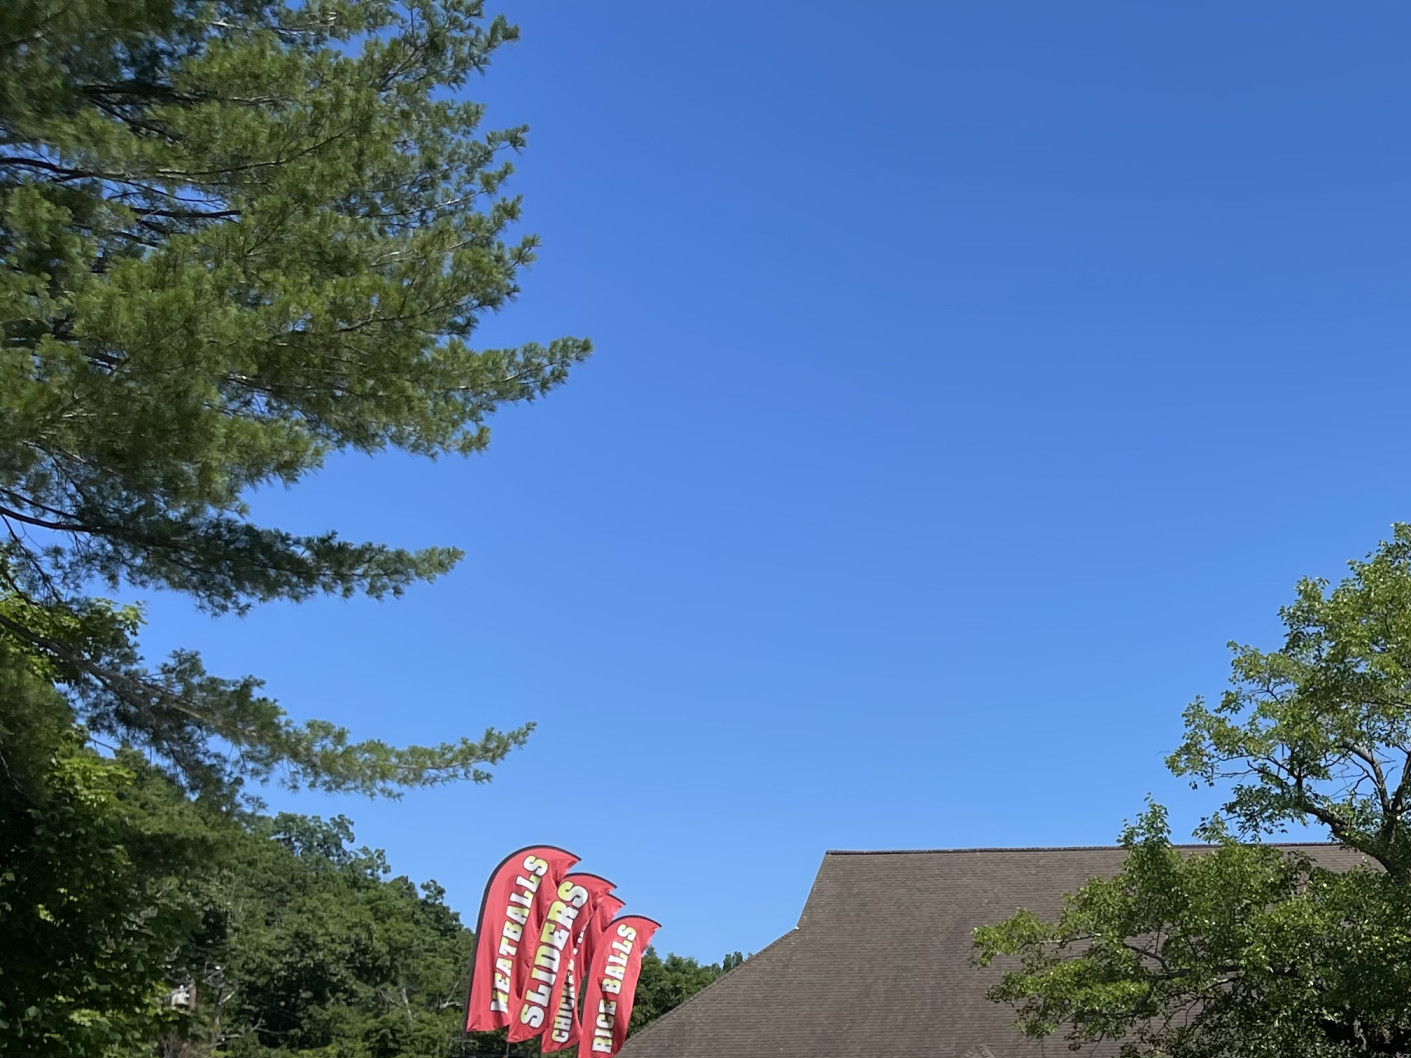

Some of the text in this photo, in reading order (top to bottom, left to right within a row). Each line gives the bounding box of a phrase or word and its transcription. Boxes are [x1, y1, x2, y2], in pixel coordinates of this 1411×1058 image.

[490, 855, 549, 1014] MEATBALLS
[520, 880, 589, 1029] SLIDERS
[592, 923, 637, 1054] RICE BALLS
